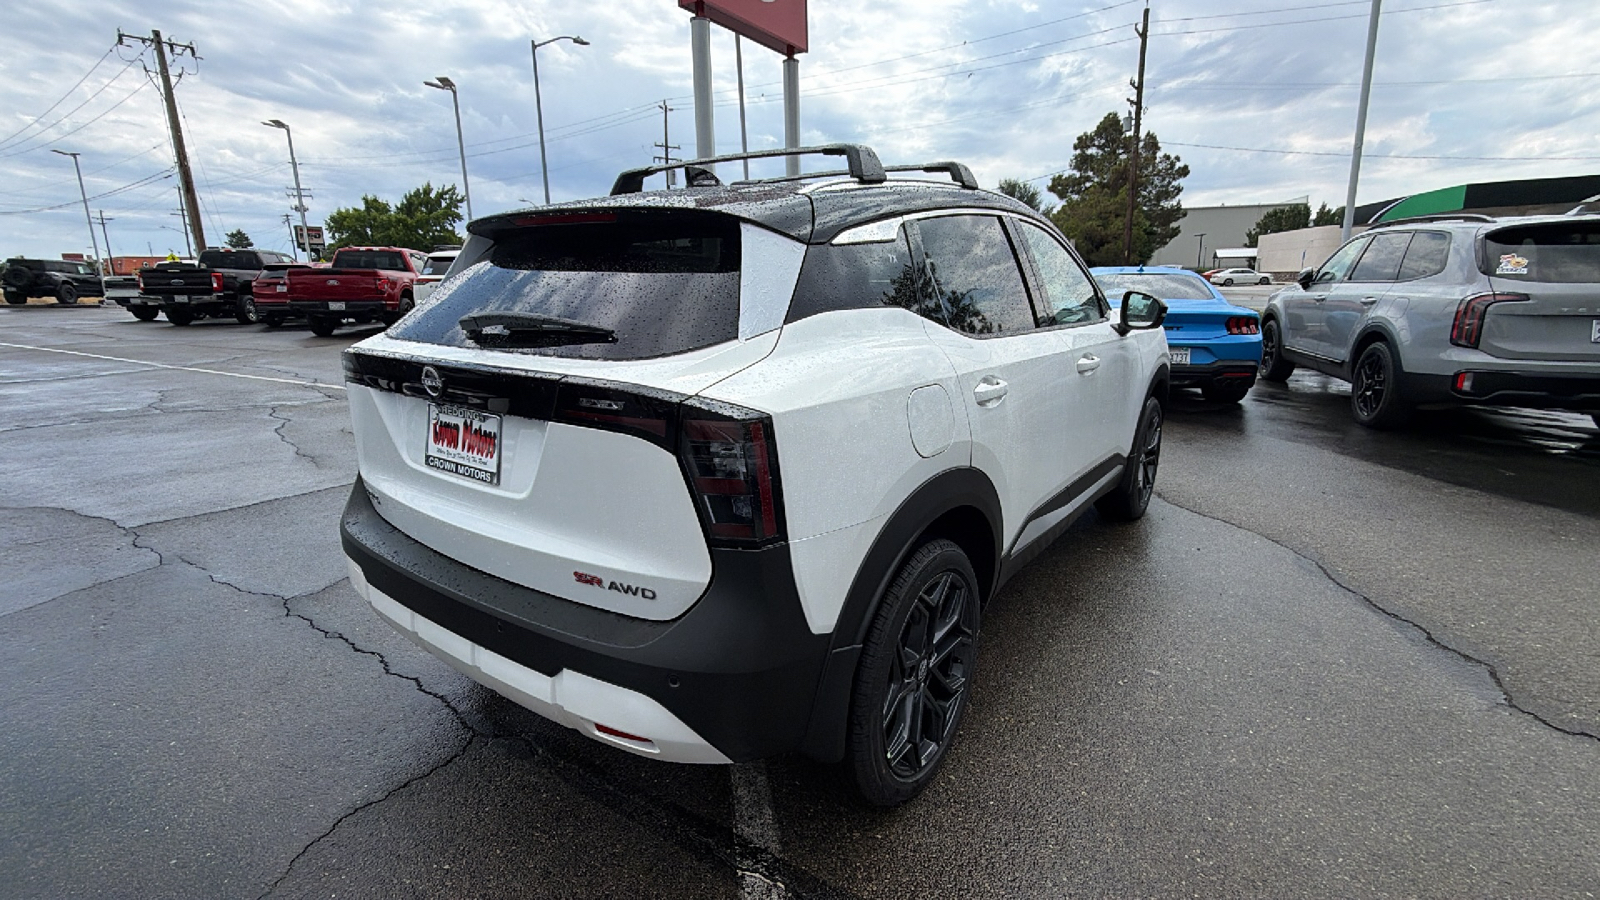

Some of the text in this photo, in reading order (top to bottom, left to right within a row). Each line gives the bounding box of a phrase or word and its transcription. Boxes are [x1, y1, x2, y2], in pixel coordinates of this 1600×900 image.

[462, 418, 497, 460] Motors
[428, 456, 491, 482] CROWN MOTORS
[608, 581, 657, 600] AWD
